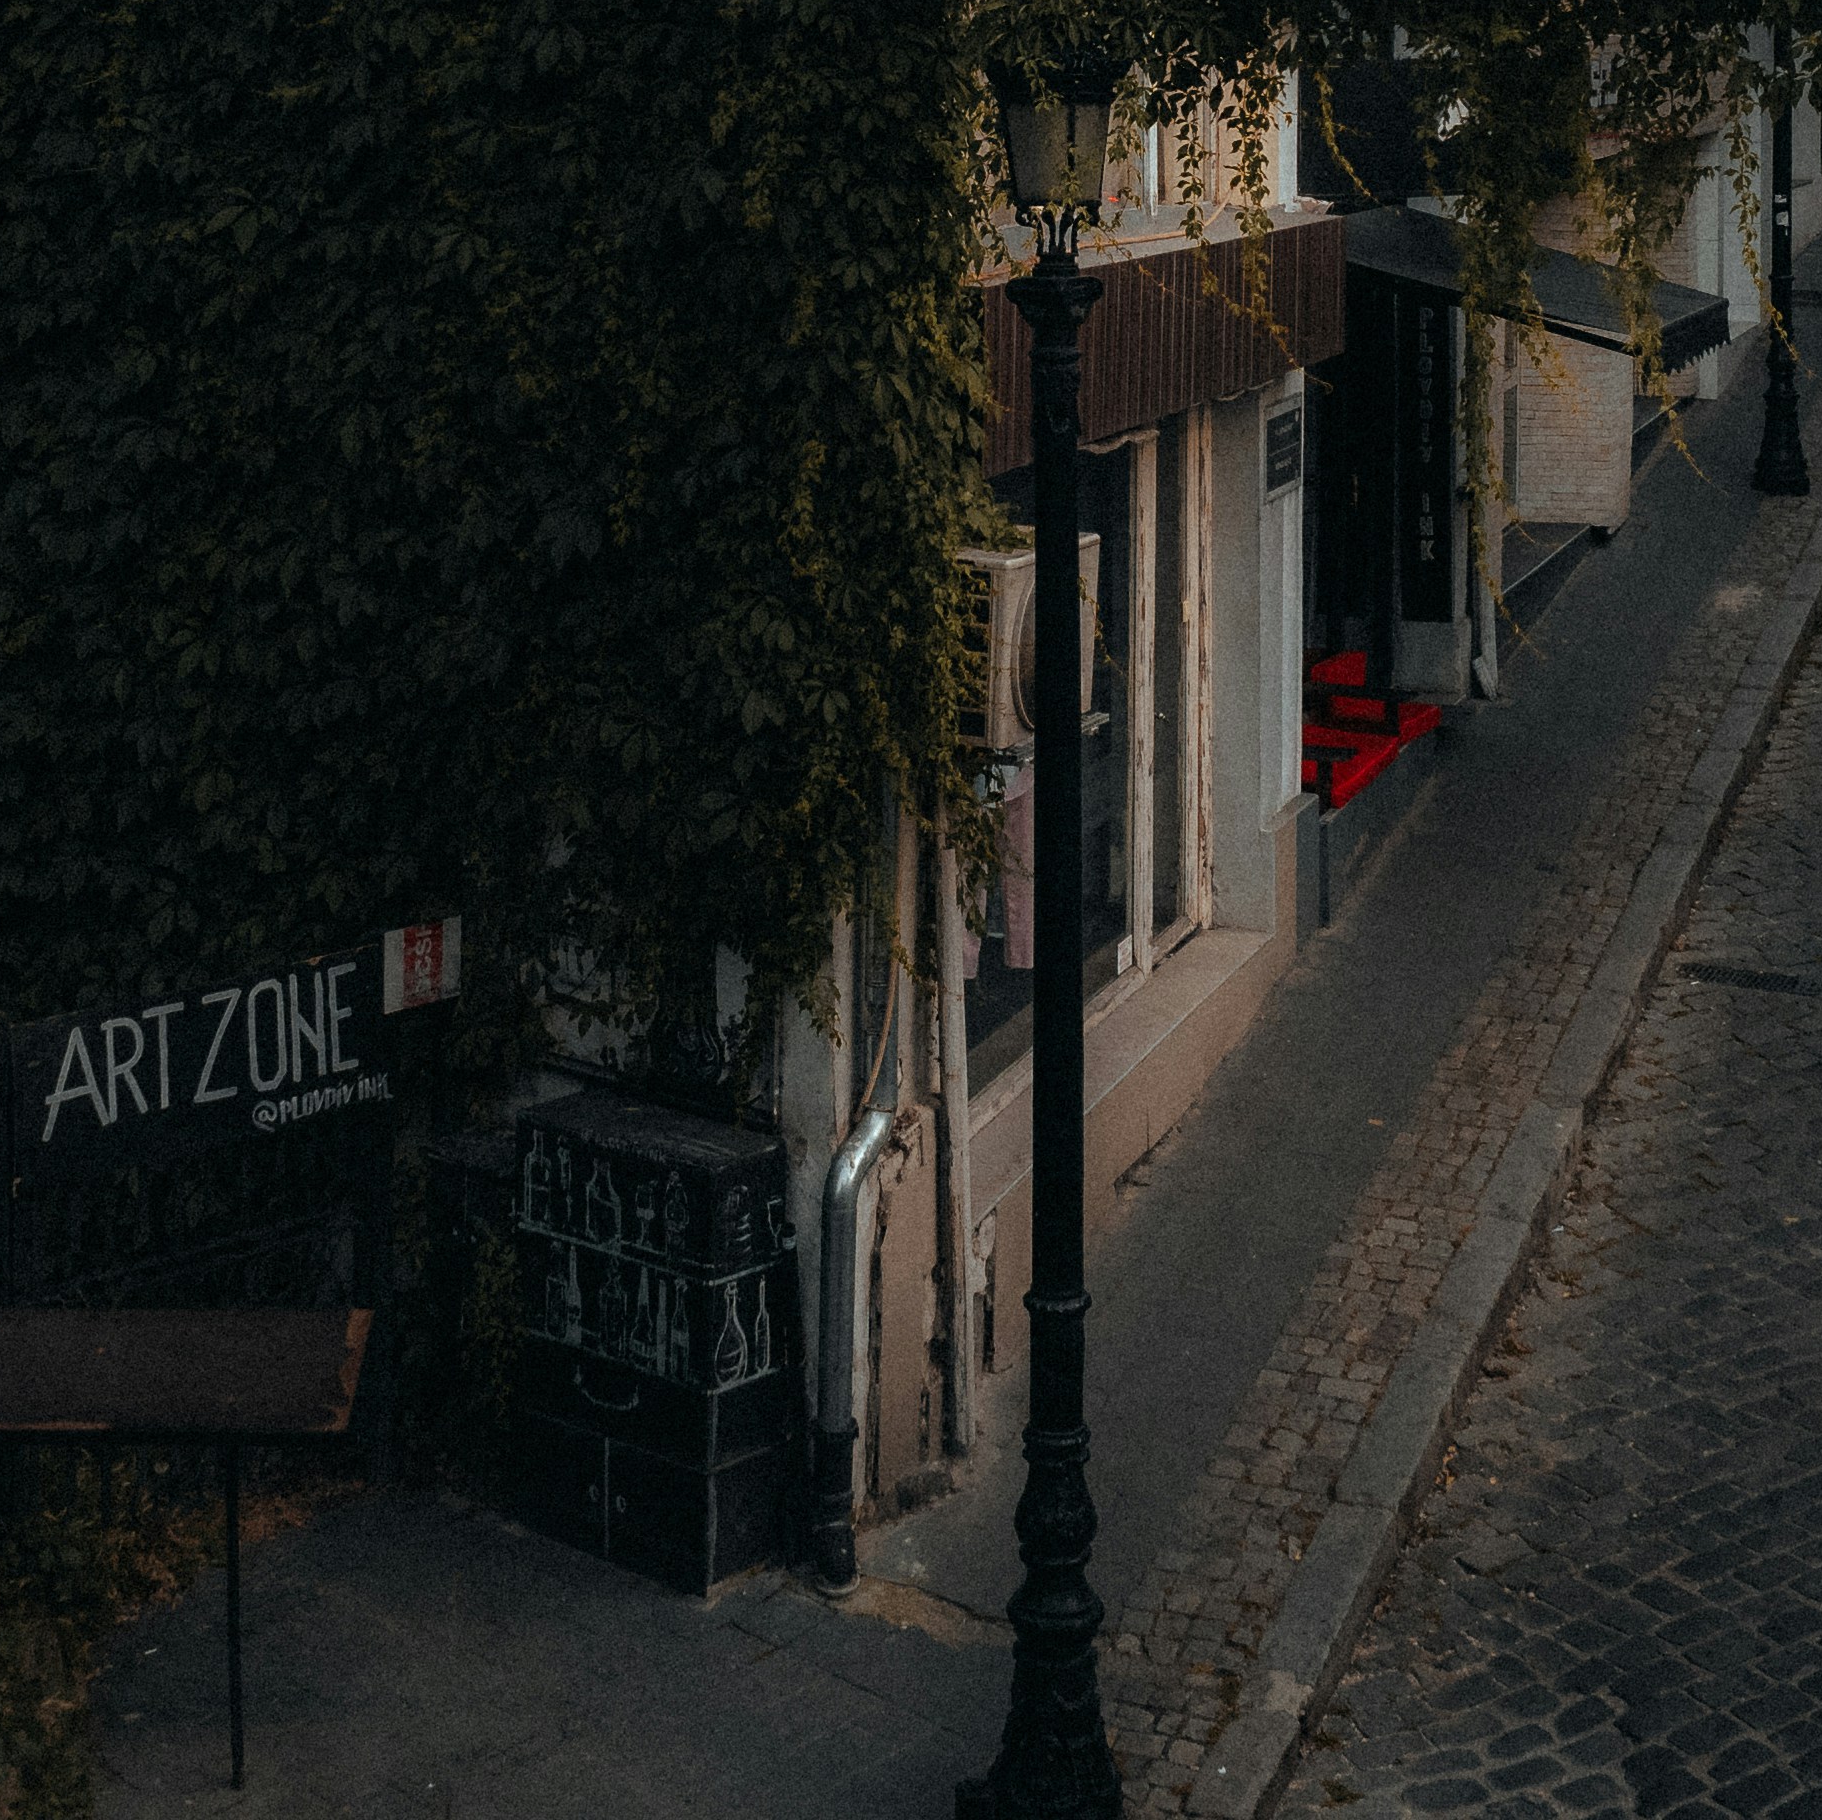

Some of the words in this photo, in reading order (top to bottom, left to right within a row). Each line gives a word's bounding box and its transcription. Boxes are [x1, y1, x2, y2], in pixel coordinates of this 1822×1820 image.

[1417, 307, 1435, 464] PLOVDIV
[1418, 493, 1435, 561] INK
[40, 1002, 185, 1143] ART
[193, 961, 360, 1103] ZONE
